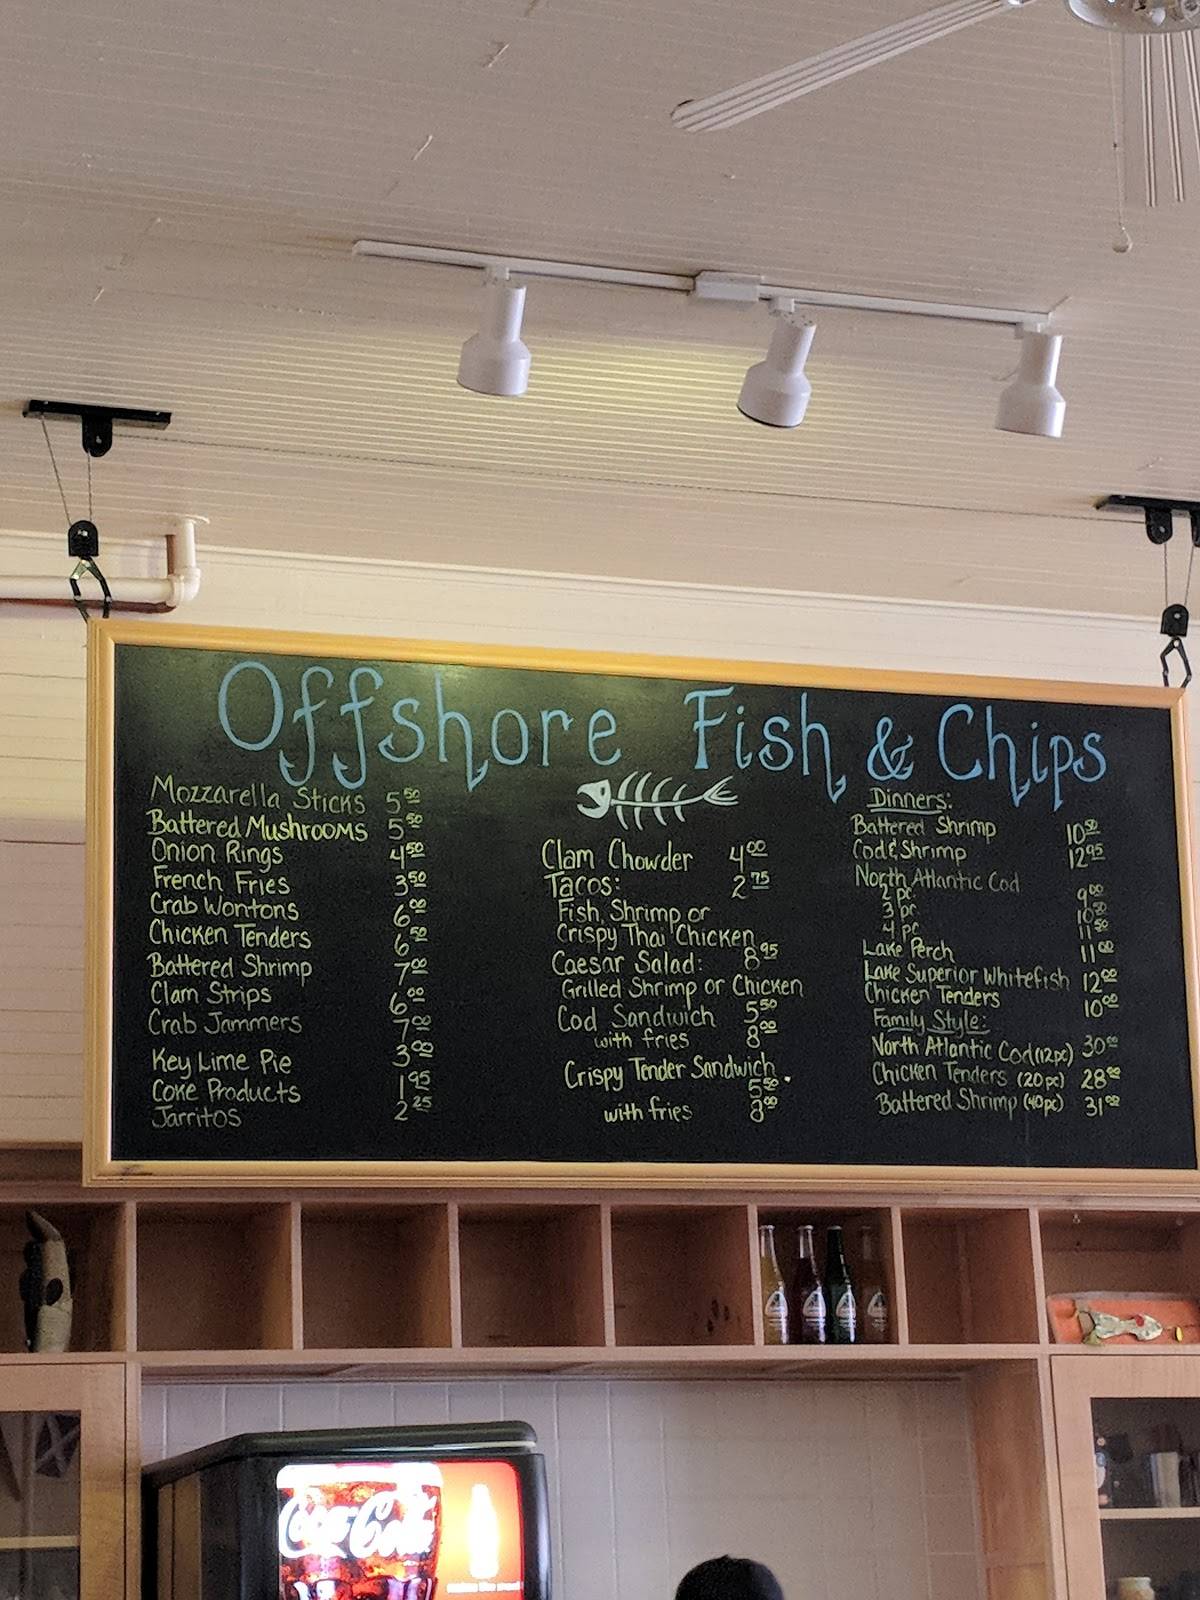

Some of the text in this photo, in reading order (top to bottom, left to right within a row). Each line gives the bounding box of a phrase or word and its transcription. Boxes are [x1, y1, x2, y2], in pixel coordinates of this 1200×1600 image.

[218, 660, 1107, 811] Offshore Fish & Chips
[150, 774, 281, 809] Mozzarella
[293, 786, 366, 815] Sticks
[866, 787, 953, 812] Dinners:
[146, 809, 241, 838] Battered
[851, 814, 925, 836] Battered
[935, 815, 997, 844] Shrimp
[151, 838, 216, 864] Onion
[226, 840, 284, 873] Rings
[541, 838, 595, 870] Clam
[608, 837, 693, 872] Chowder
[153, 865, 223, 892] French
[235, 870, 291, 896] Fries
[543, 871, 621, 898] Tacos:
[855, 864, 1020, 893] North Atlantic Cod
[881, 884, 891, 901] 2
[150, 892, 198, 915] Crab
[203, 896, 299, 921] Wontons
[610, 898, 681, 934] Shrimp
[687, 906, 712, 923] or
[882, 902, 894, 918] 3
[149, 918, 228, 947] Chicken
[234, 923, 312, 949] Tenders
[557, 922, 755, 953] Crispy Thai Chicken
[882, 920, 895, 939] 4
[552, 950, 624, 976] Caesar
[634, 950, 703, 976] Salad:
[863, 940, 902, 956] Lake
[911, 937, 955, 962] Perch
[147, 952, 234, 979] Battered
[241, 954, 313, 987] Shrimp
[864, 961, 900, 981] Lake
[906, 963, 978, 990] Superior
[983, 966, 1070, 991] Whitefish
[151, 980, 199, 1006] Clam
[207, 980, 272, 1011] Strips
[562, 974, 804, 1009] Grilled Shrimp or Chicken
[864, 982, 930, 1004] Chicken
[936, 984, 1000, 1008] Tenders
[148, 1008, 197, 1035] Crab
[203, 1011, 302, 1035] Jammers
[557, 1004, 598, 1032] Cod
[611, 1003, 717, 1029] Sandwich
[873, 1008, 989, 1038] Family Style:
[594, 1031, 633, 1050] with
[641, 1027, 690, 1050] fries
[872, 1032, 919, 1057] North
[925, 1035, 992, 1060] Atlantic
[151, 1047, 192, 1080] Key
[199, 1050, 250, 1072] Lime
[260, 1049, 292, 1075] Pie
[564, 1060, 624, 1092] Crispy
[628, 1056, 687, 1081] Tender
[691, 1051, 777, 1080] Sandwich
[873, 1061, 937, 1086] Chicken
[943, 1061, 1007, 1087] Tenders
[152, 1078, 198, 1102] Coke
[208, 1078, 301, 1104] Products
[876, 1090, 950, 1115] Battered
[956, 1088, 1017, 1120] Shrimp
[152, 1105, 242, 1128] Jarritos
[604, 1103, 644, 1123] with
[648, 1095, 693, 1122] fries
